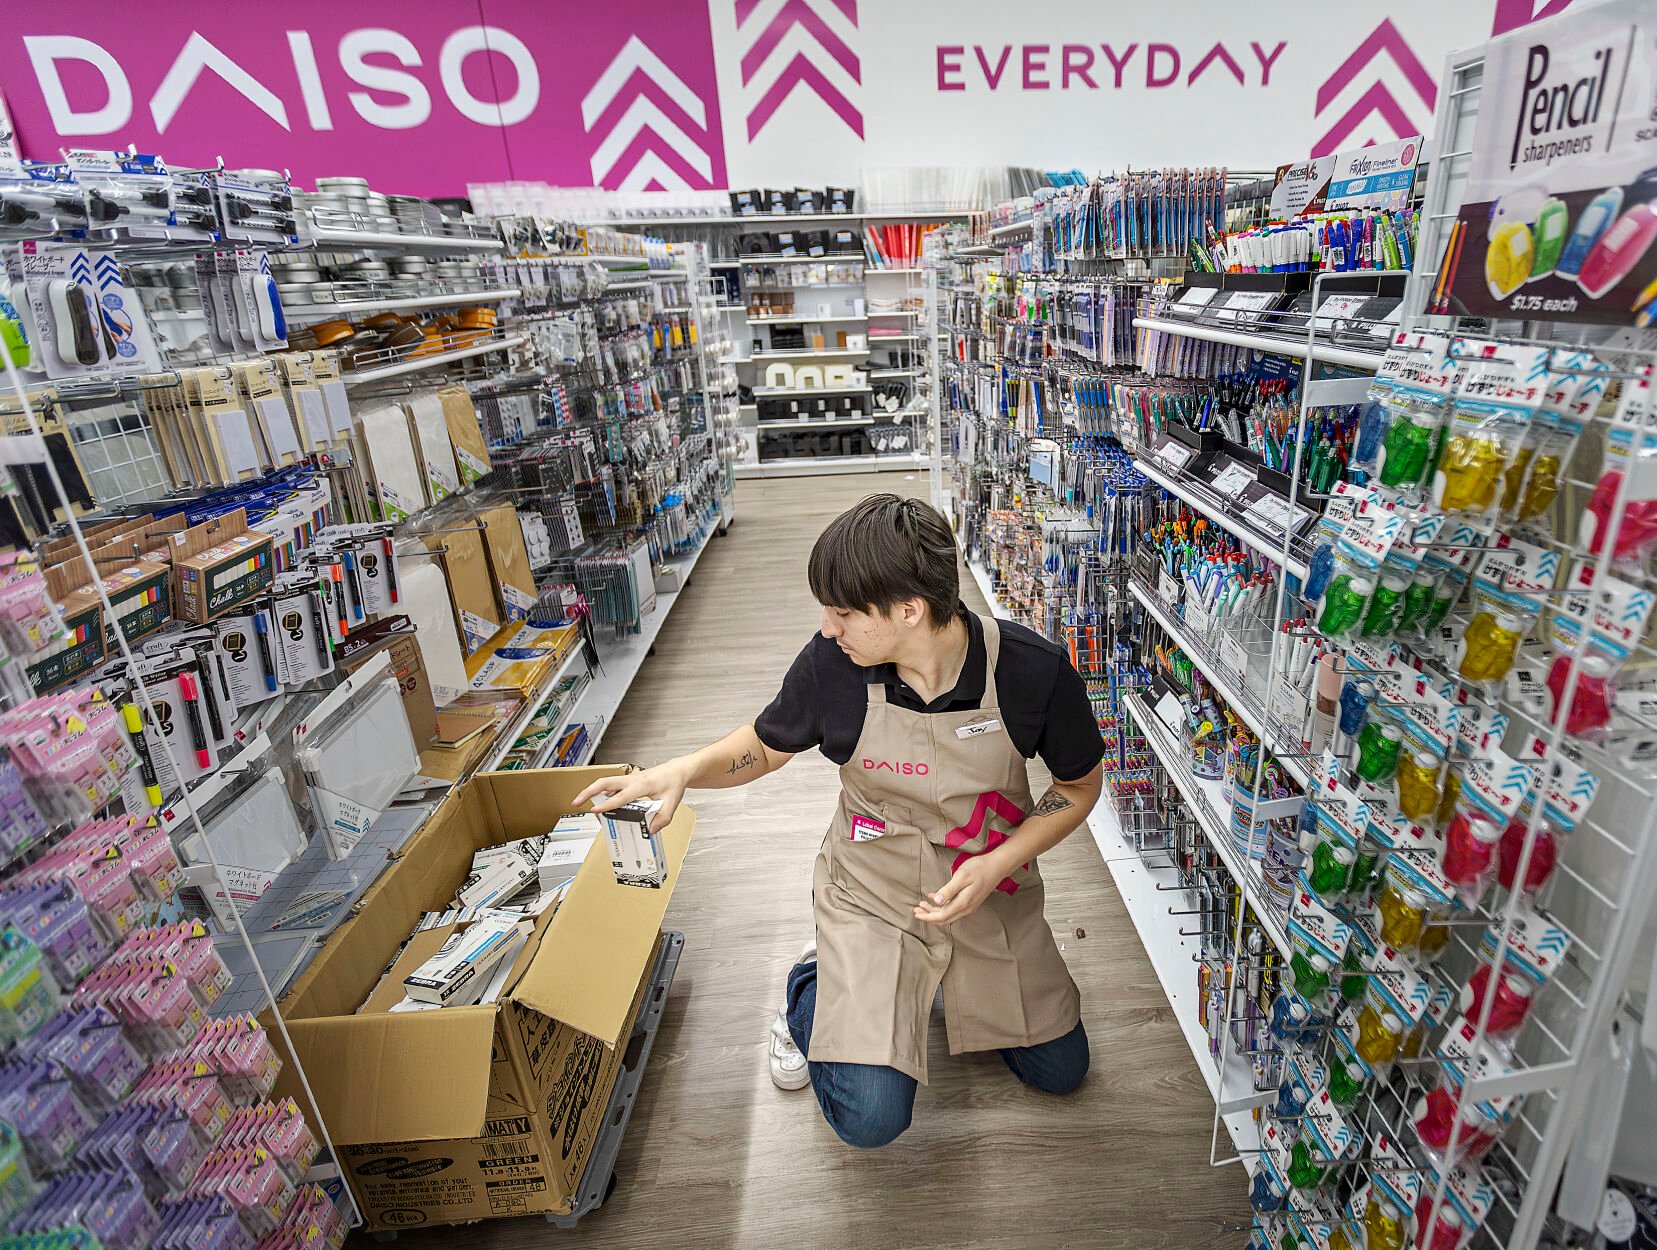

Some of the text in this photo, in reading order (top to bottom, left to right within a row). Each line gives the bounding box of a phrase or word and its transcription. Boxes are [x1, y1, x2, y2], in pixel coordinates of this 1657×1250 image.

[936, 41, 1288, 91] EVERYDAY
[22, 26, 540, 136] DAISO
[1510, 44, 1613, 173] Pencil
[1634, 128, 1657, 142] sc
[1523, 135, 1593, 166] sharpeners
[1510, 295, 1578, 312] $1.75 each
[1357, 322, 1377, 331] PILO
[210, 588, 234, 609] Chalk
[863, 759, 929, 776] DAISO
[410, 977, 438, 988] ZEBRA
[451, 968, 475, 990] ZEBRA
[486, 1157, 533, 1167] GREEN
[395, 1200, 441, 1208] INDUSTRIES
